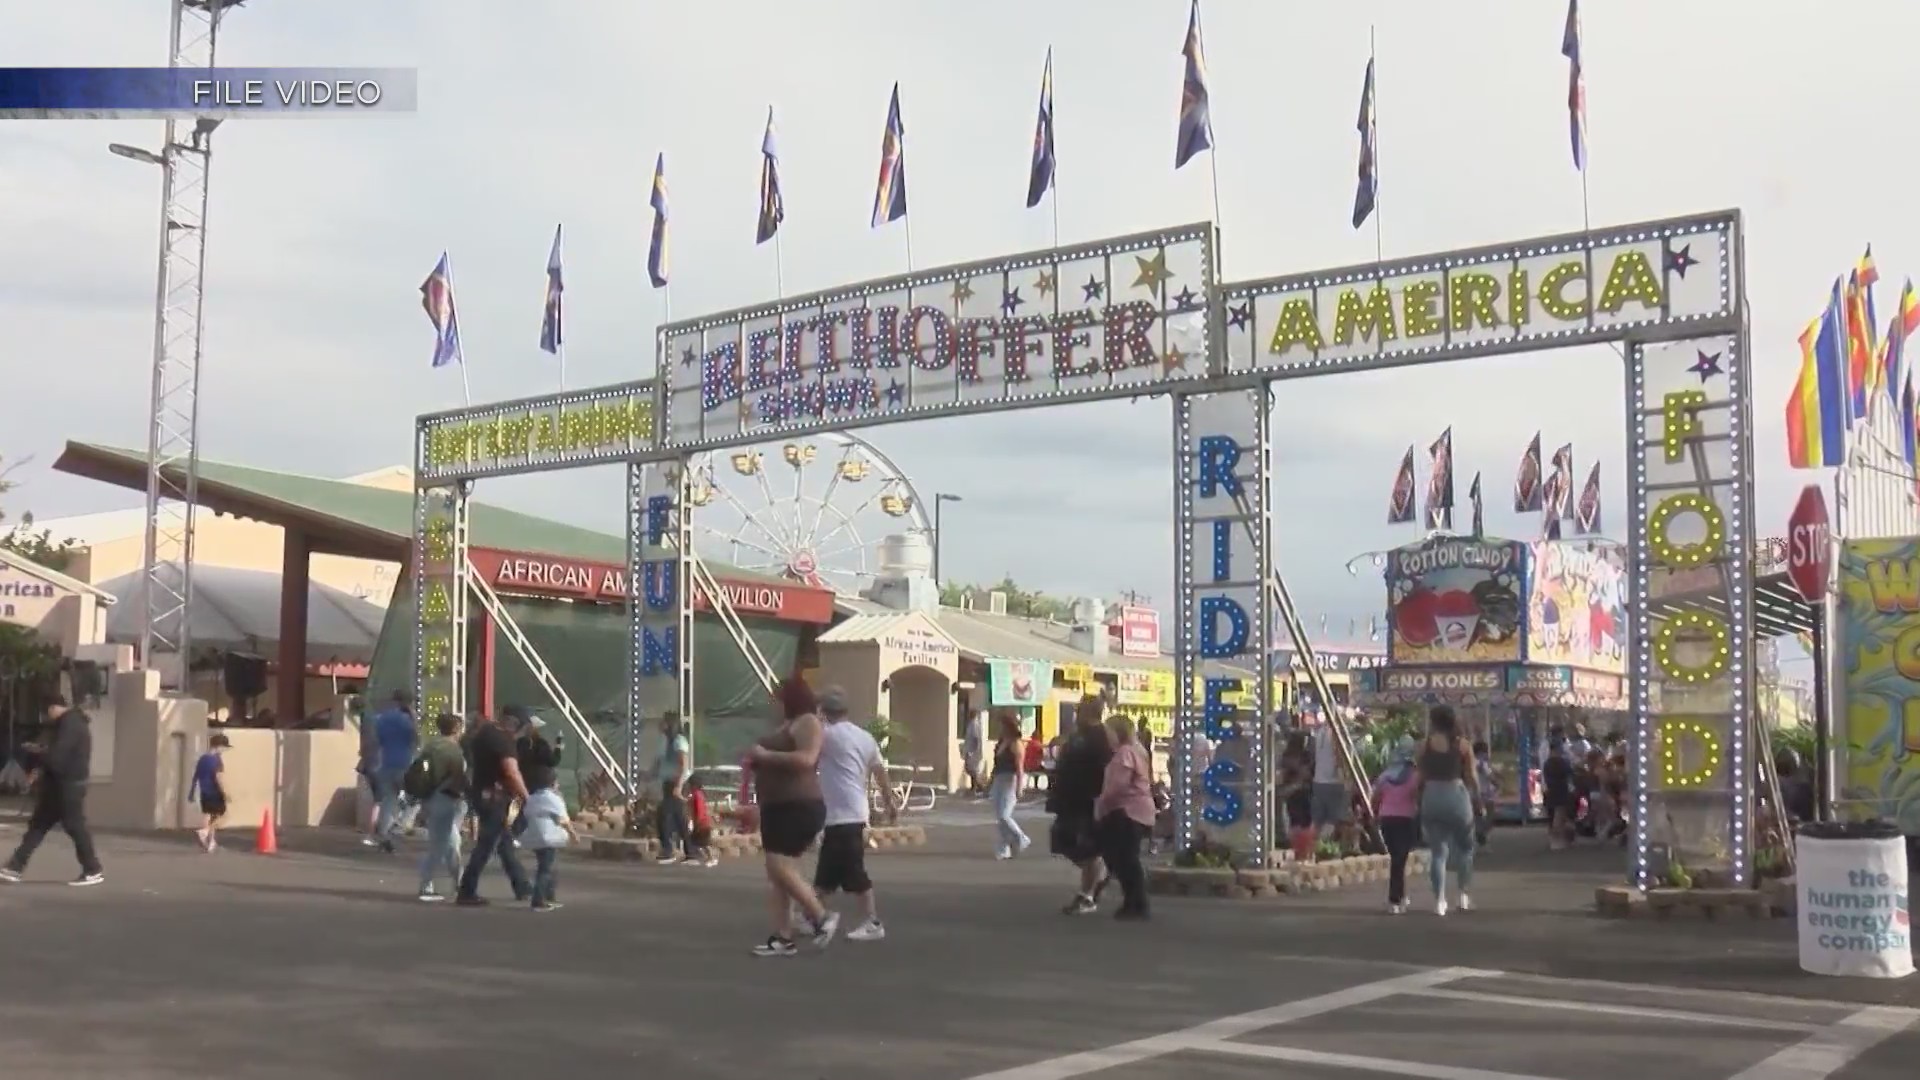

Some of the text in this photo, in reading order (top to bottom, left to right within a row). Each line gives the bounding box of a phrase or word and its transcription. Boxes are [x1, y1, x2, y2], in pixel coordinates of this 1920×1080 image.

[1269, 251, 1666, 354] AMERICA
[702, 301, 1159, 412] REITHOFFER
[758, 376, 880, 423] SHOWS
[1402, 547, 1458, 574] COTTON
[1463, 546, 1512, 568] CANDY
[1792, 523, 1828, 566] STOP
[498, 559, 592, 588] AFRICAN
[643, 495, 677, 679] FUN
[1648, 391, 1730, 791] FOOD
[1200, 435, 1249, 828] RIDES
[1387, 674, 1427, 689] SNO
[1431, 673, 1498, 689] KONES
[1527, 671, 1562, 681] COLD
[1848, 868, 1889, 888] the
[1808, 887, 1889, 909] human
[1808, 911, 1892, 934] energy
